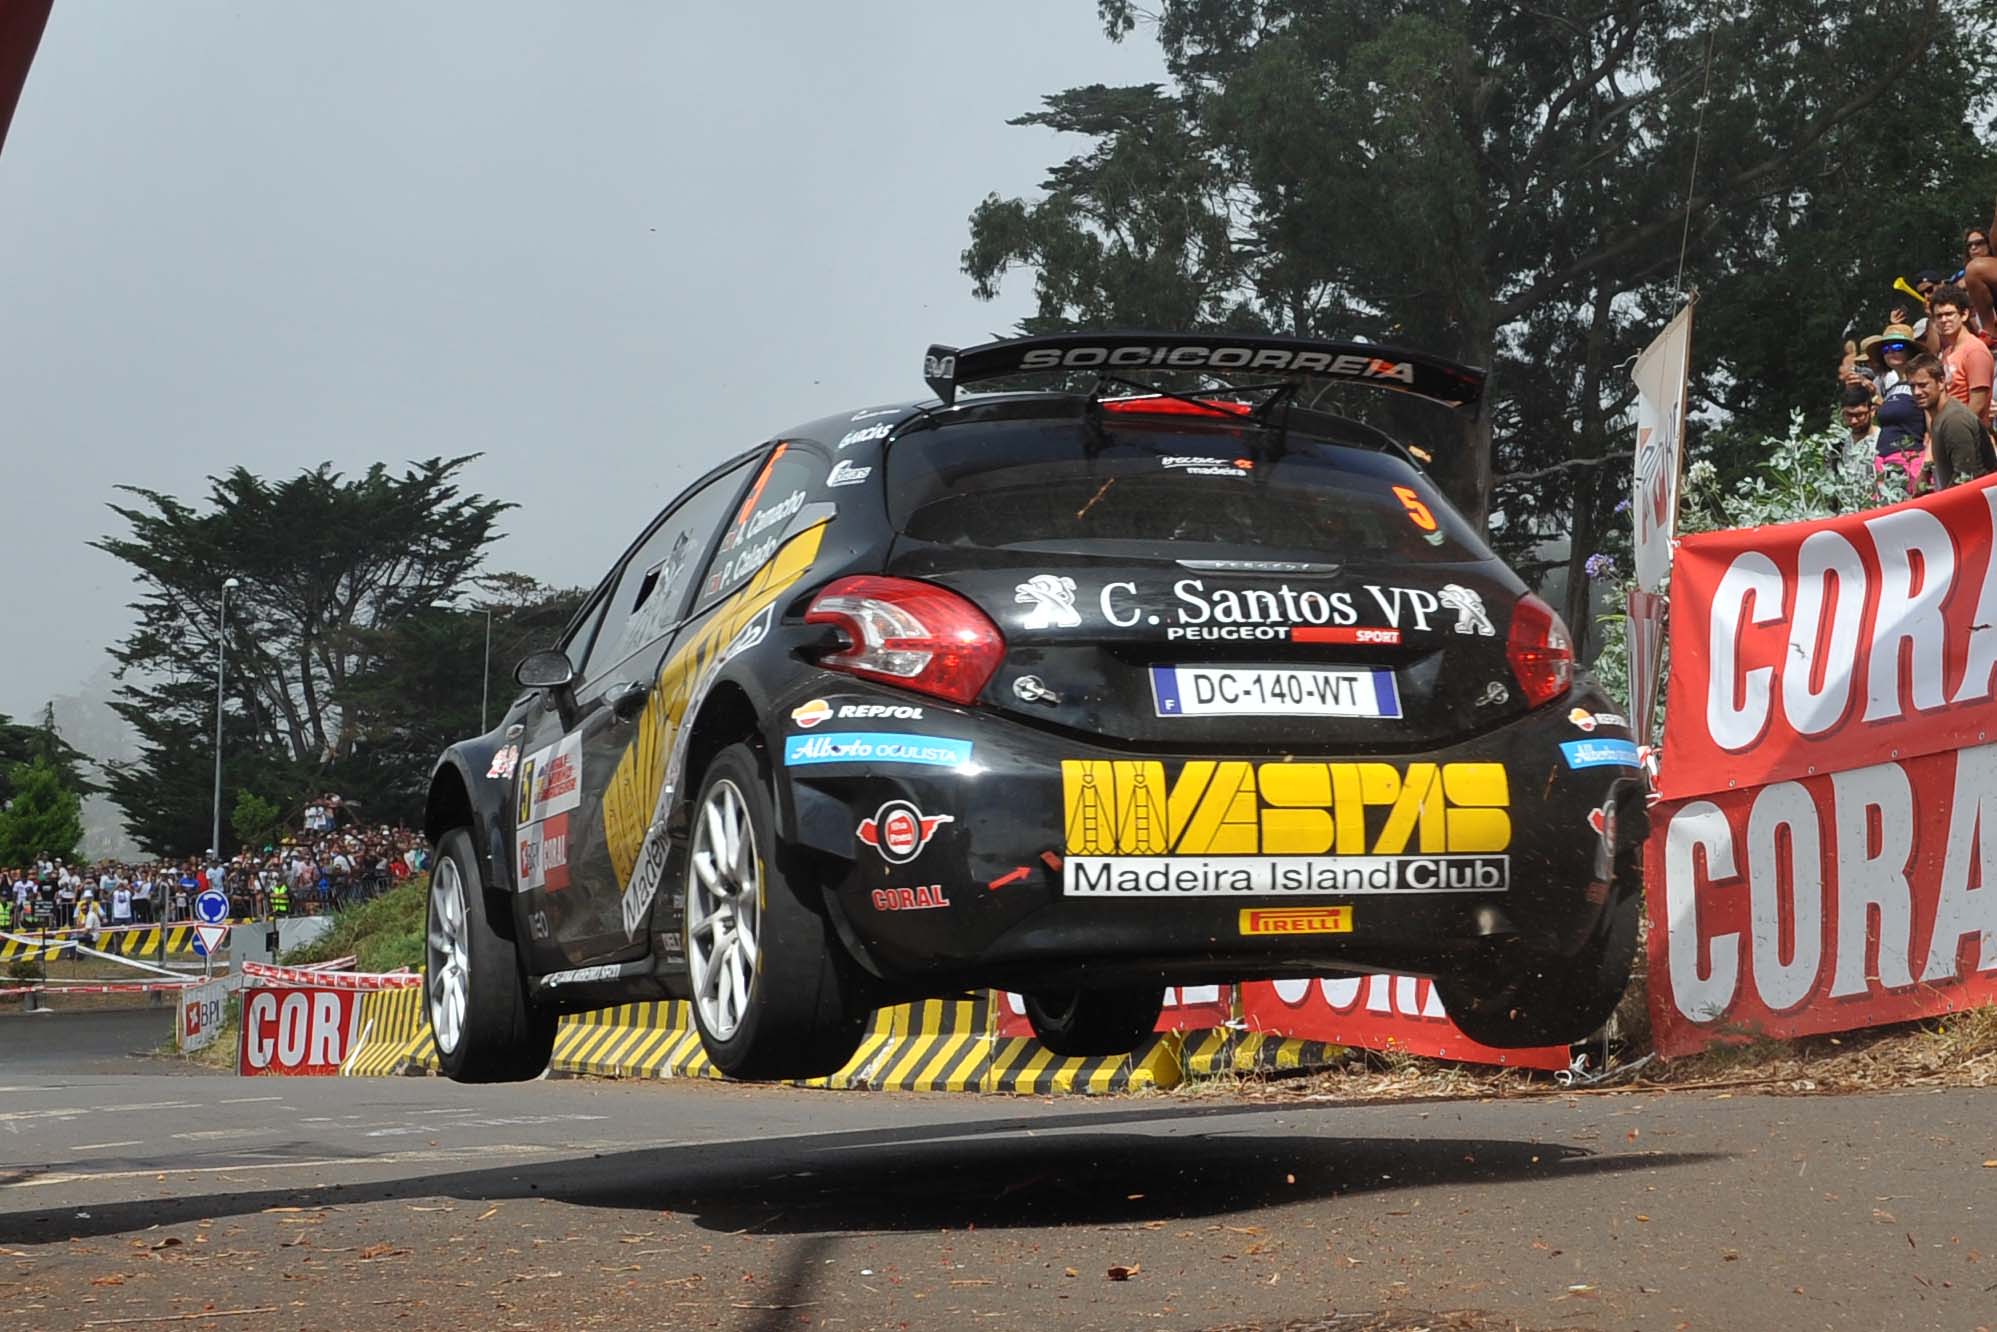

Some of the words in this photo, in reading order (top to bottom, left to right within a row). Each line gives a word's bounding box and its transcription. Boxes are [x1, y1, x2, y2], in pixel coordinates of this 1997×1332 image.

[1019, 346, 1414, 384] SOCICORREIA
[1391, 486, 1438, 531] 5
[1100, 582, 1161, 627] C.
[1173, 579, 1359, 626] Santos
[1363, 584, 1440, 632] VP
[1167, 626, 1290, 641] PEUGEOT
[1356, 629, 1400, 643] SPORT
[1194, 673, 1358, 707] DC-140-WT
[838, 705, 923, 719] REPSOL
[1165, 699, 1175, 711] F
[791, 737, 872, 759] Alberto
[875, 744, 957, 761] OCULISTA
[1073, 862, 1254, 892] Madeira
[1269, 861, 1398, 889] Island
[1404, 859, 1500, 888] Club
[871, 885, 951, 910] CORAL
[1250, 910, 1341, 932] PIRELLI
[201, 999, 220, 1027] BPI
